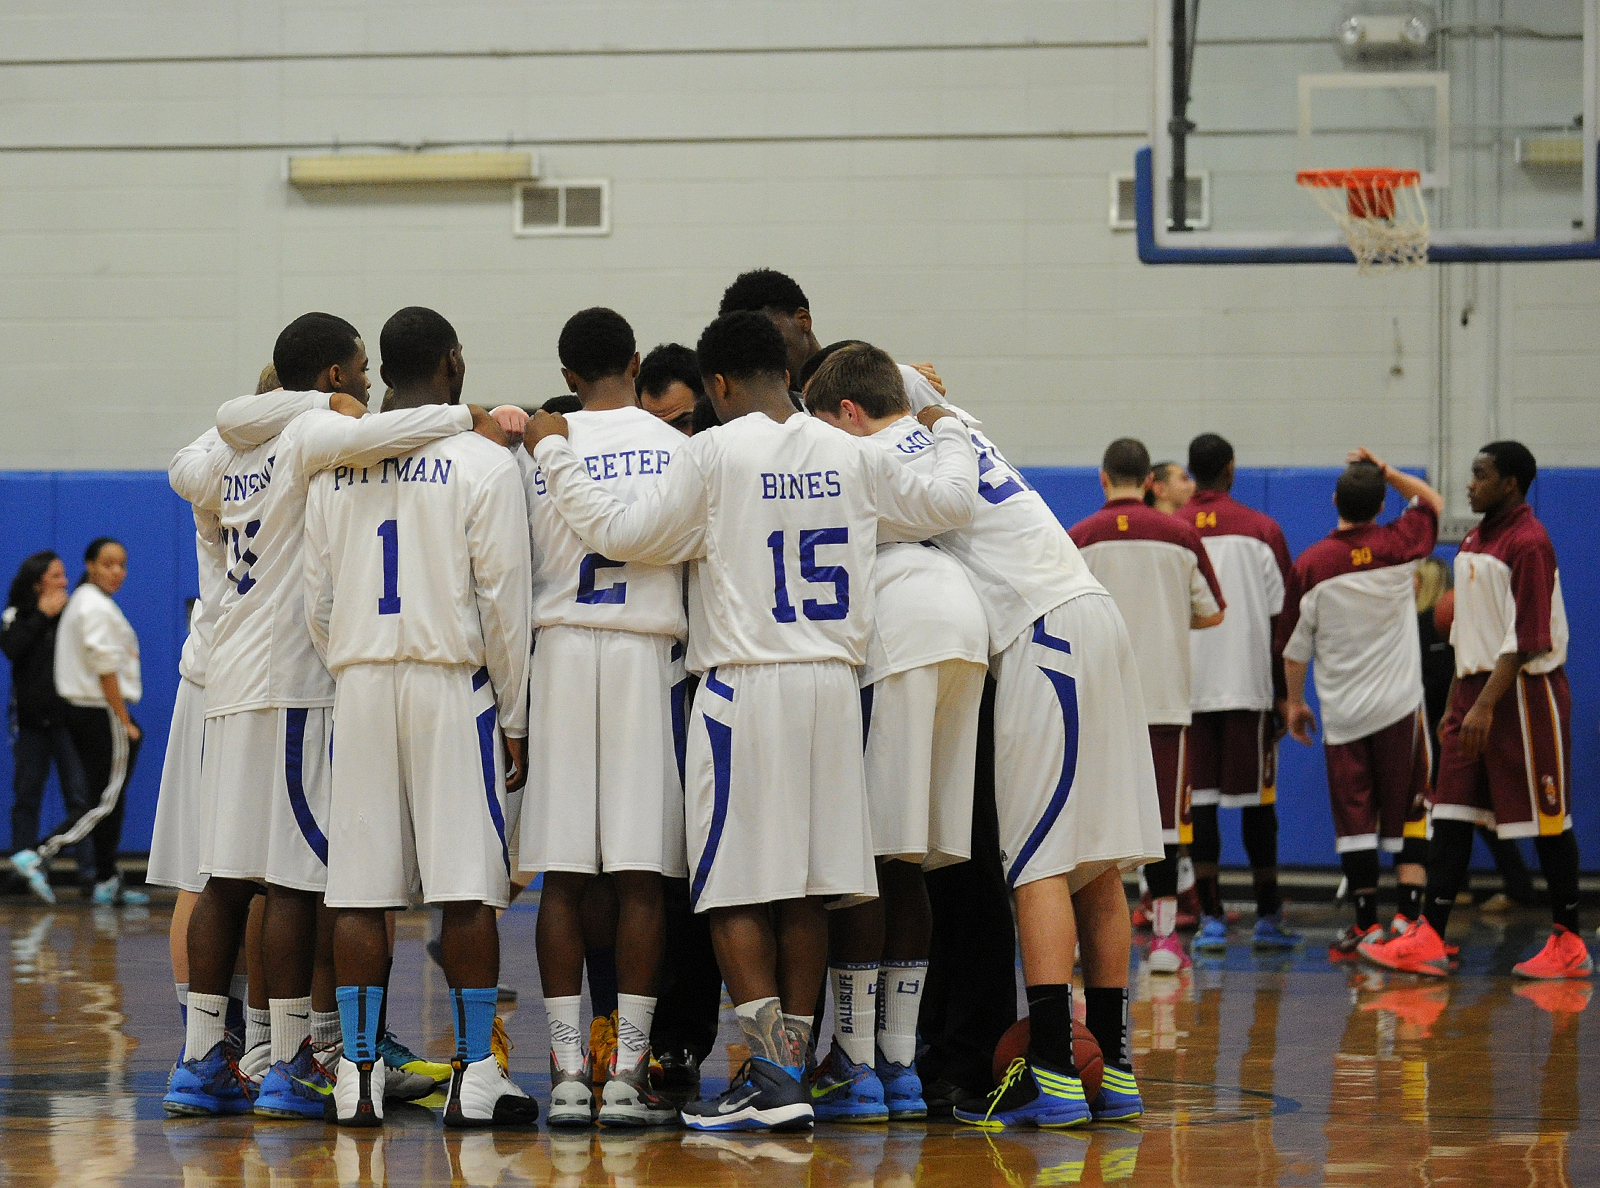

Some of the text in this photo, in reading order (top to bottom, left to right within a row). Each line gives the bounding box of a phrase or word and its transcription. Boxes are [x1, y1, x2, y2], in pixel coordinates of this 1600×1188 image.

[334, 456, 453, 491] PITTMAN
[760, 470, 842, 500] BINES
[376, 518, 402, 615] 1
[767, 526, 850, 624] 15
[838, 973, 854, 1034] BALLISLIFE
